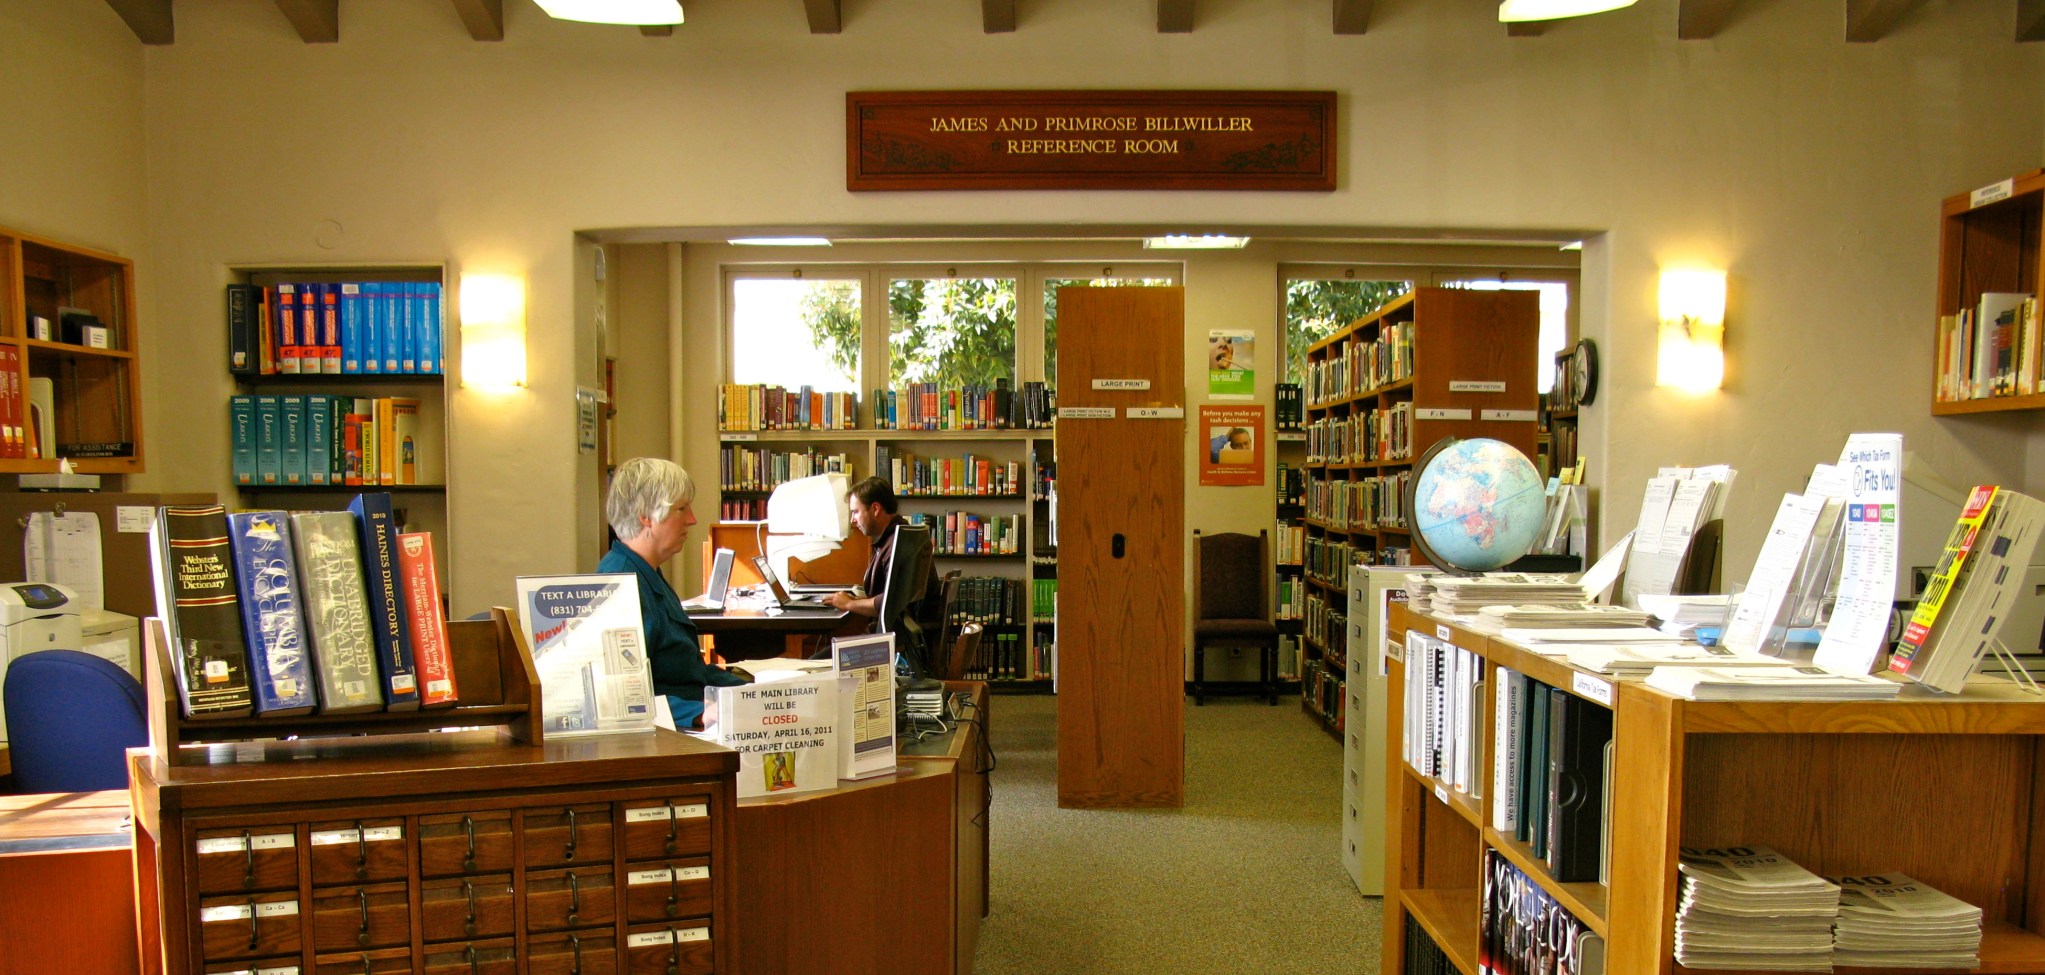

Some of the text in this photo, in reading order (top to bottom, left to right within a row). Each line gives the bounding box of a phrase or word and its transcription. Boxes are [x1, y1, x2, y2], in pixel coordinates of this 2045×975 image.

[930, 117, 1254, 132] JAMES AND PRIMROSE BILLWILLER
[1006, 139, 1180, 154] REFERENCE ROOM
[83, 443, 121, 451] ASSISTANCE
[1850, 452, 1858, 463] See
[1859, 450, 1871, 462] Which
[1863, 467, 1896, 491] Fits You!
[252, 540, 278, 553] The
[375, 523, 390, 573] HAINES
[184, 554, 219, 564] Webster's
[178, 568, 229, 581] International
[181, 563, 224, 573] Third New
[416, 563, 424, 576] The
[183, 580, 226, 590] Dictionary
[411, 577, 419, 588] for
[541, 592, 565, 600] TEXT
[576, 590, 618, 599] LIBRARI
[382, 569, 400, 637] DIRECTORY
[413, 589, 425, 617] LARGE
[419, 577, 435, 639] Merriam-Webster
[269, 558, 300, 667] COLUMBIA
[326, 559, 356, 669] DICTIONARY
[341, 558, 372, 676] UNABRIDGED
[550, 605, 574, 616] (831)
[416, 617, 428, 643] PRINT
[535, 620, 568, 644] New!
[741, 687, 819, 699] THE MAIN LIBRARY
[764, 701, 797, 711] WILL BE
[1509, 685, 1518, 728] magazines
[762, 714, 798, 725] CLOSED
[725, 726, 832, 742] SATURDAY, APRIL 16, 2011
[734, 738, 825, 754] FOR CARPET CLEANING
[1508, 751, 1516, 759] to
[1507, 788, 1515, 807] have
[1507, 808, 1514, 822] We
